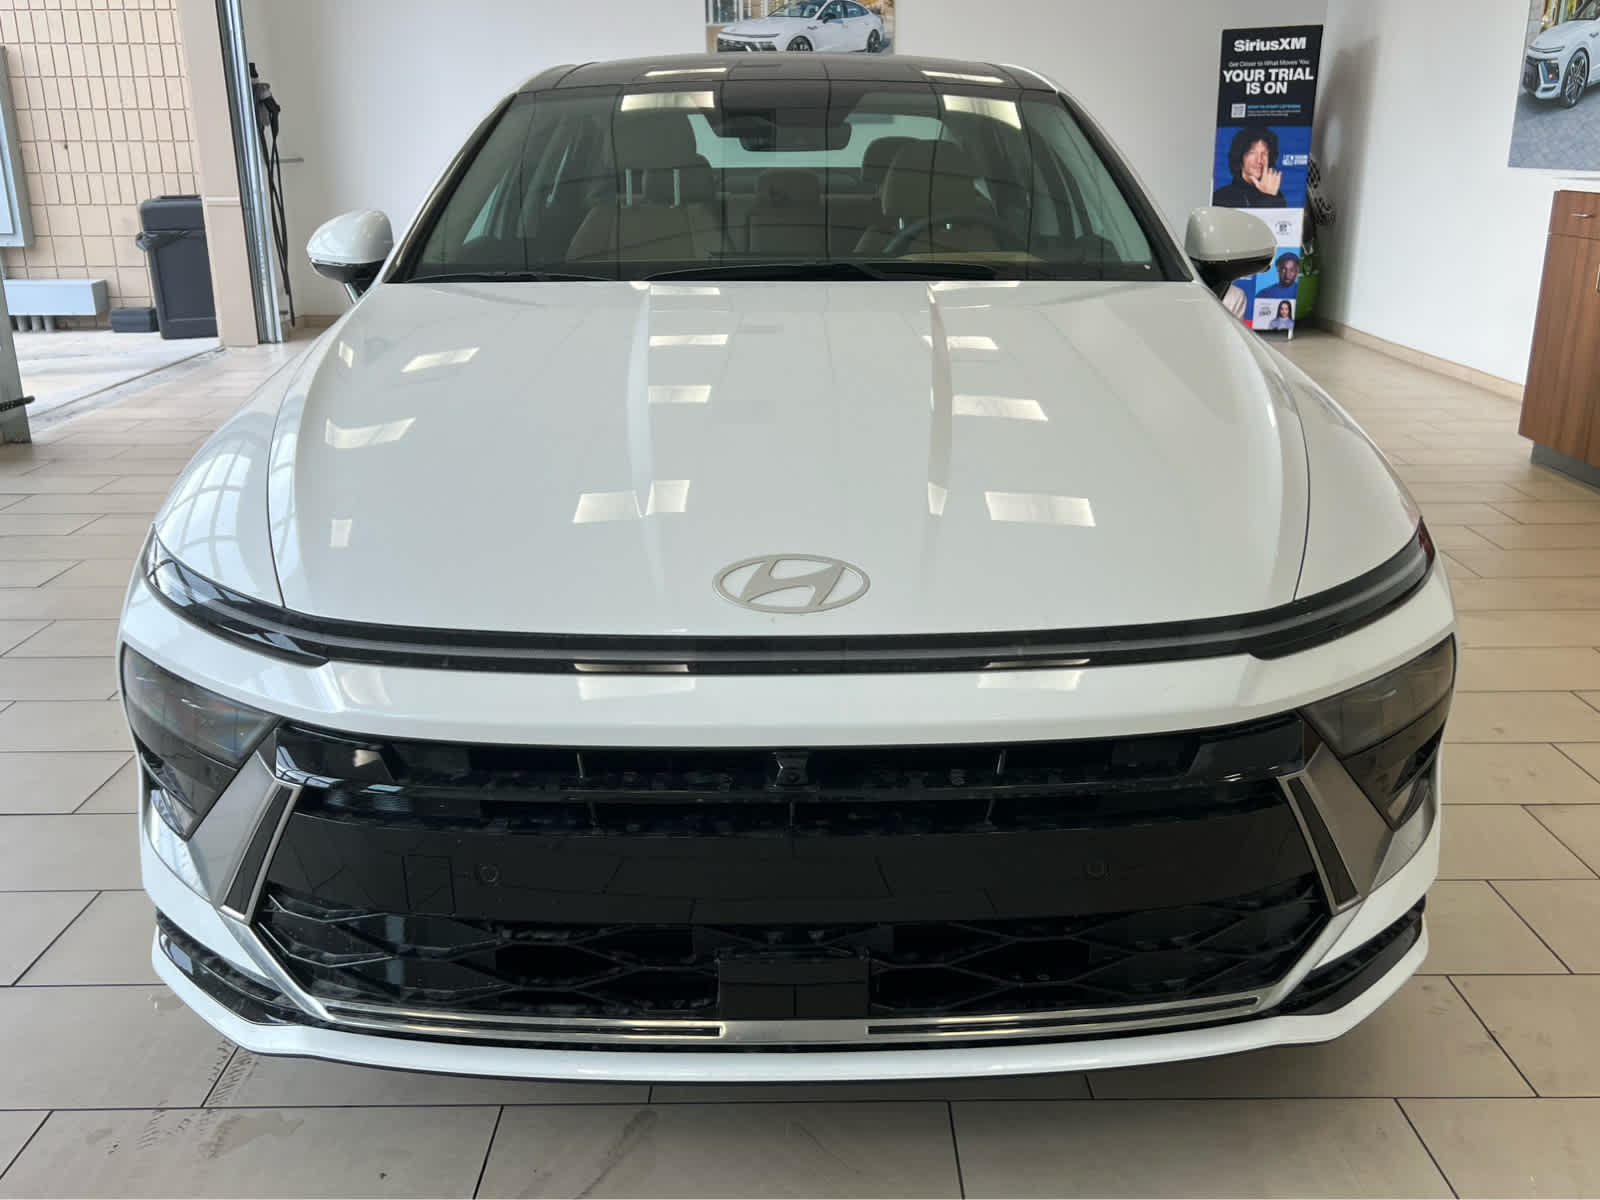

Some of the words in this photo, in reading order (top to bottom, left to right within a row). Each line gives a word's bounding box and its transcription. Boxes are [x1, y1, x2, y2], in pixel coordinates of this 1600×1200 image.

[1234, 37, 1307, 52] SiriusXM
[1223, 69, 1265, 82] YOUR
[1268, 67, 1314, 81] TRIAL
[1246, 82, 1261, 95] IS
[1264, 81, 1288, 94] ON
